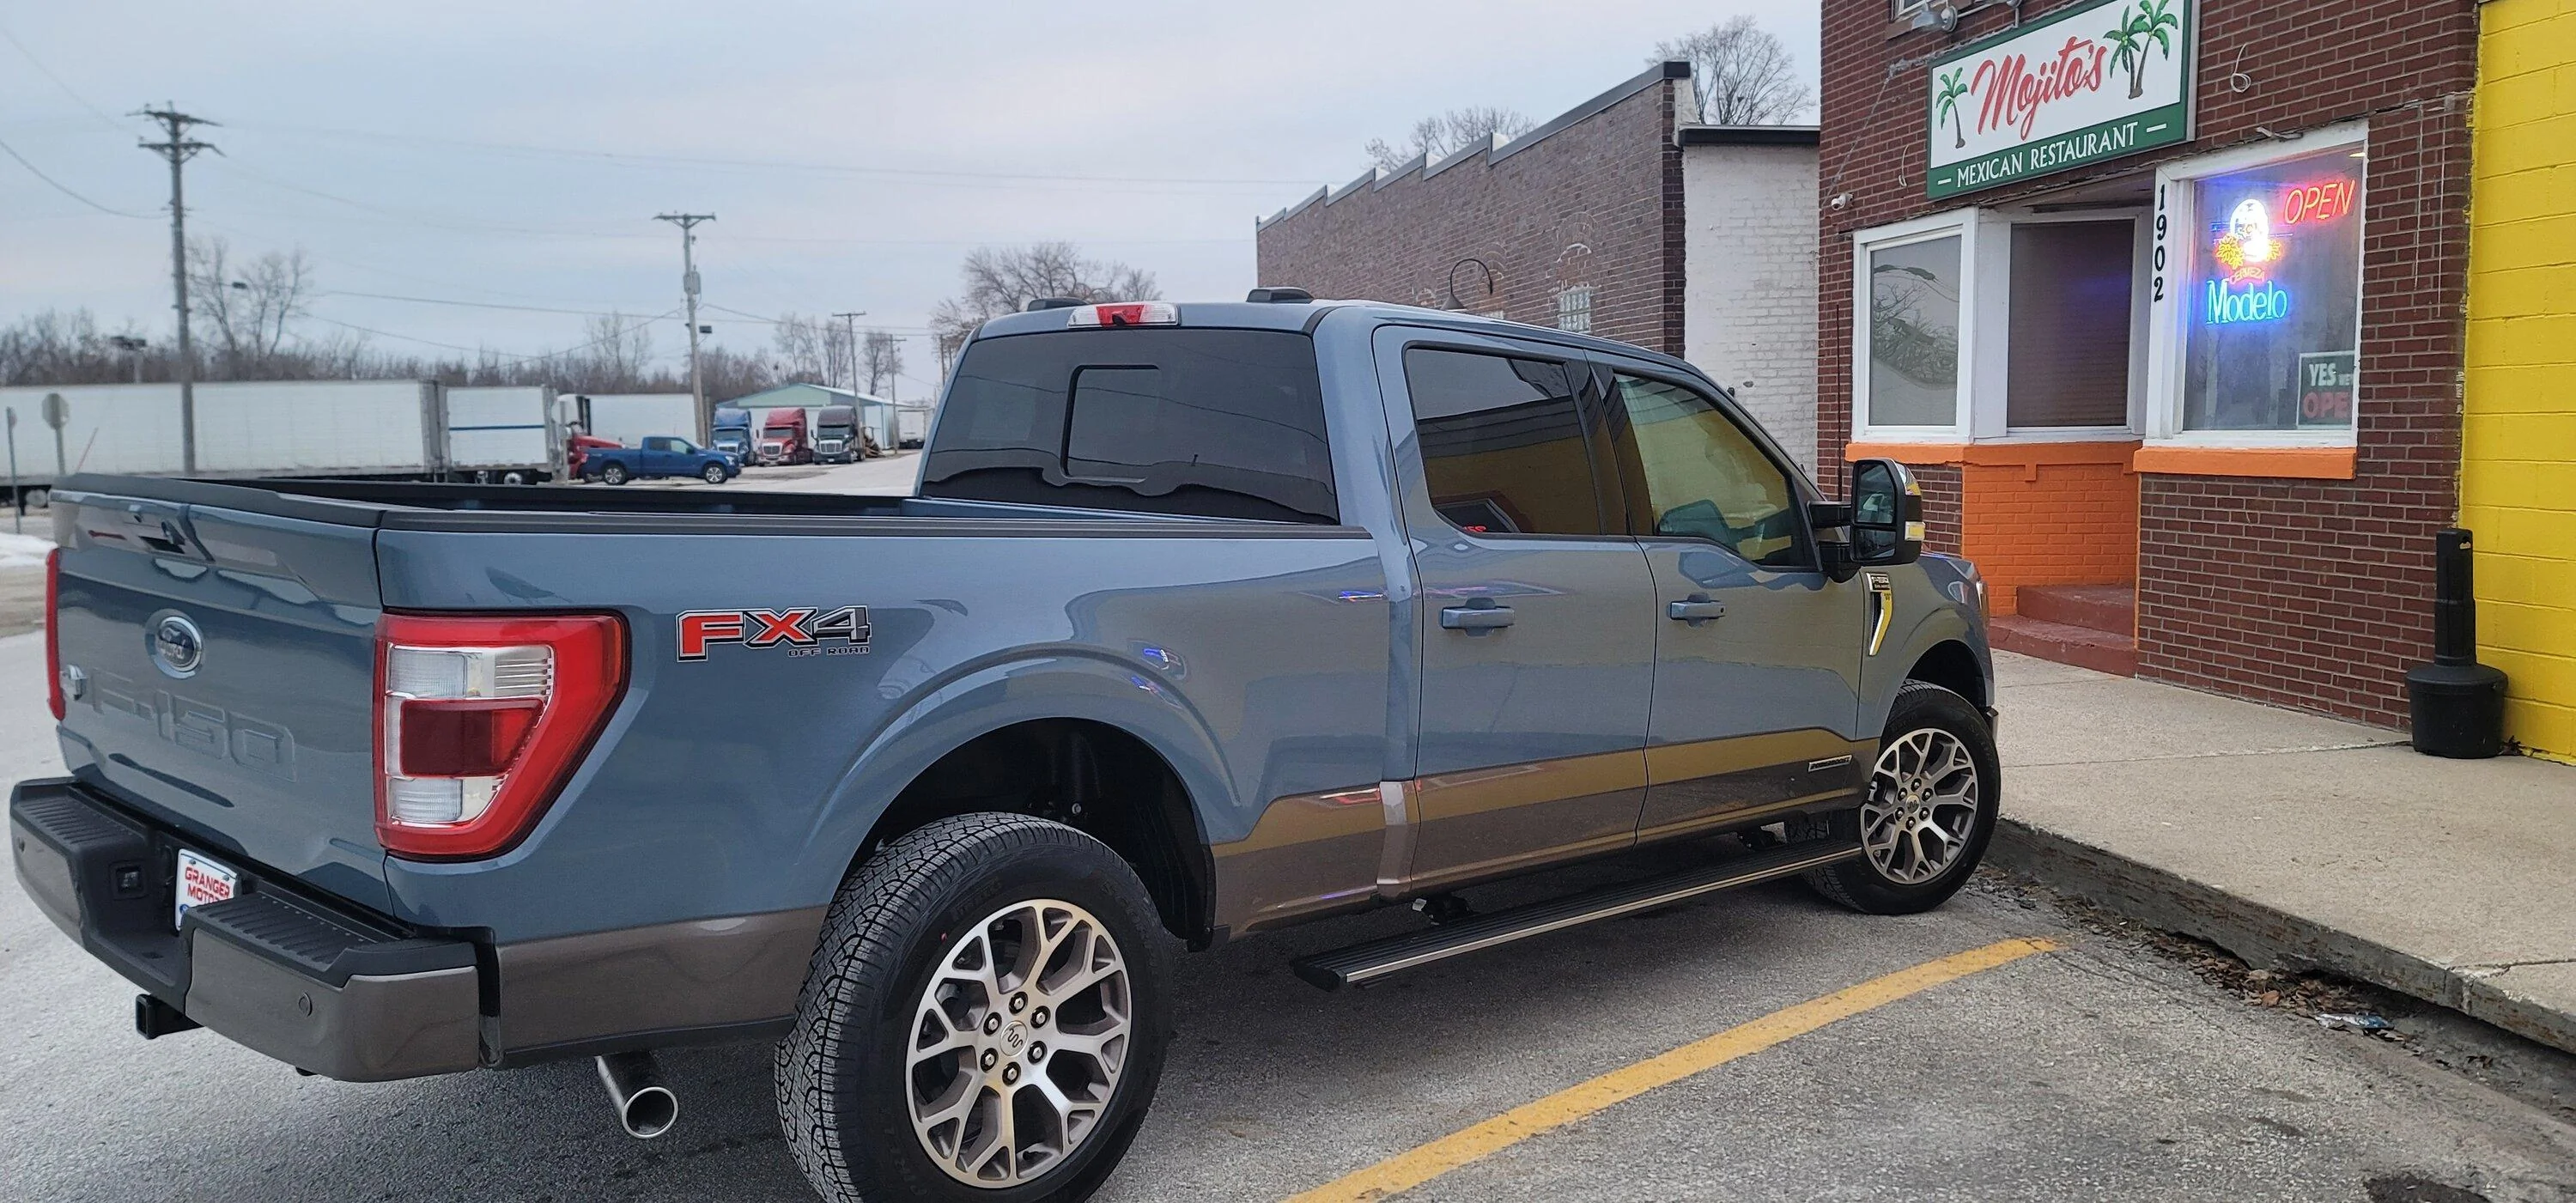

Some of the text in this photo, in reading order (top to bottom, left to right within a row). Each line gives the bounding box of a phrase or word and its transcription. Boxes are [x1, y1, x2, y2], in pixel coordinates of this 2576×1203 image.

[1971, 36, 2106, 141] Mojito's
[1957, 122, 2137, 188] MEXICAN RESTAURANT
[2284, 179, 2355, 225] OPEN
[2154, 184, 2167, 302] 1902
[2206, 279, 2287, 324] Modelo
[2309, 363, 2336, 386] YES
[2303, 392, 2351, 419] OPE
[677, 605, 872, 662] FX4
[788, 646, 870, 657] OFF ROAD
[91, 667, 296, 783] F-150
[185, 866, 230, 898] GRANGER
